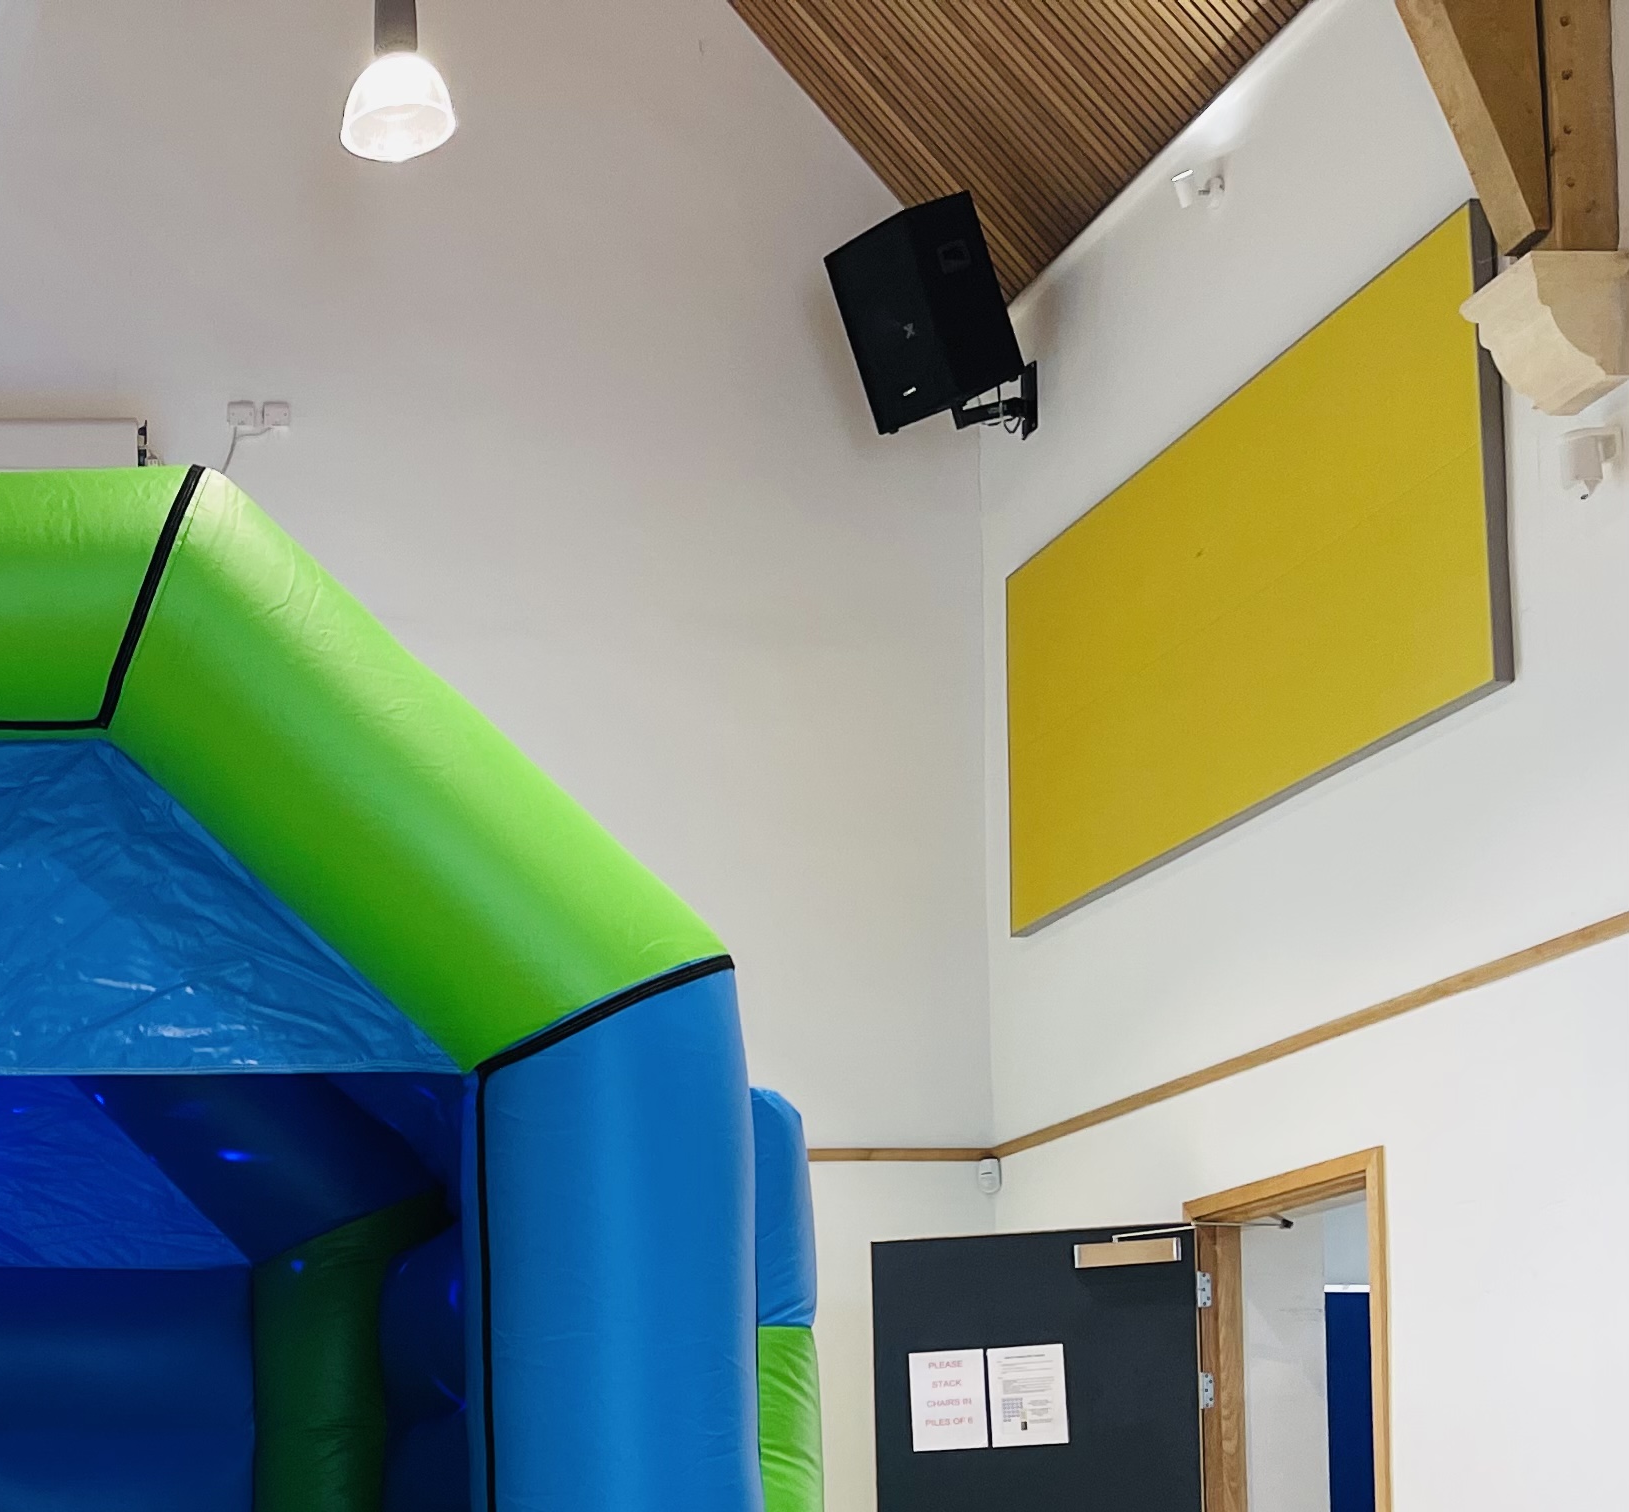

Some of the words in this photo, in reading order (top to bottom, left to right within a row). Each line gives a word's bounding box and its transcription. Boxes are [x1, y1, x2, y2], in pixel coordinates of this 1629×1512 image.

[928, 1360, 963, 1369] PLEASE
[931, 1379, 962, 1389] STACK
[926, 1399, 960, 1408] CHAIRS
[925, 1418, 950, 1427] PILES
[953, 1416, 966, 1425] OF
